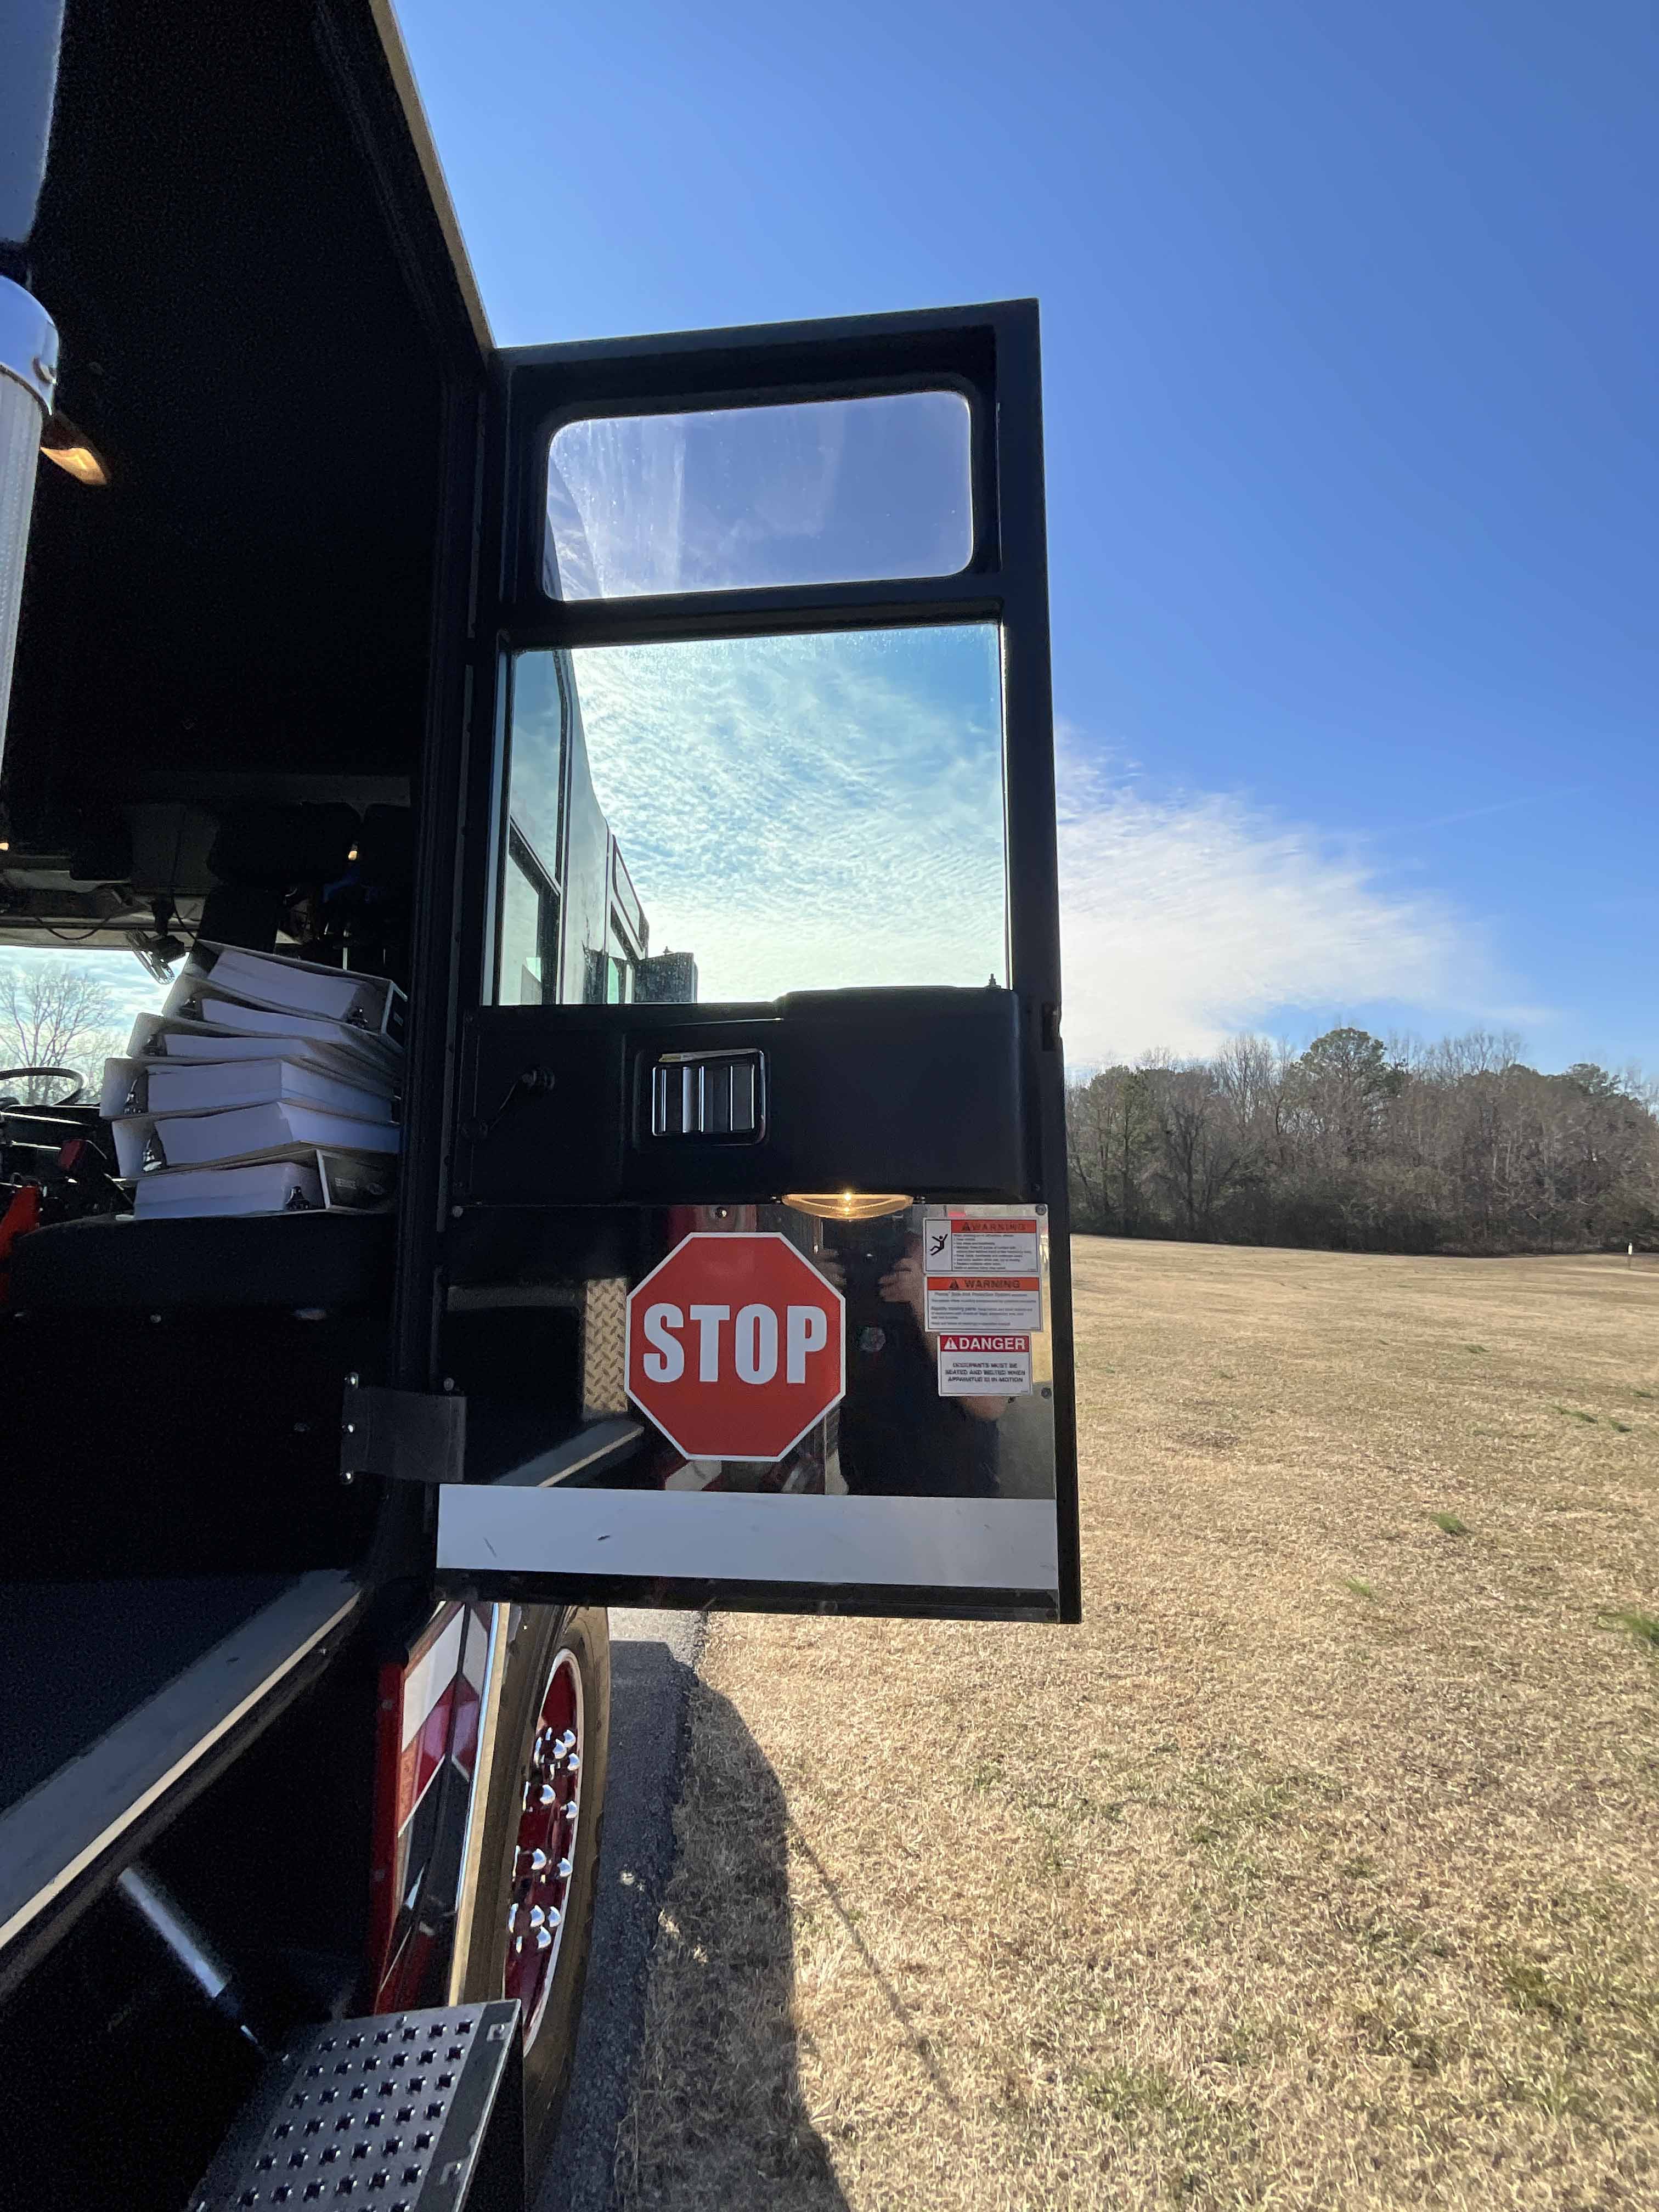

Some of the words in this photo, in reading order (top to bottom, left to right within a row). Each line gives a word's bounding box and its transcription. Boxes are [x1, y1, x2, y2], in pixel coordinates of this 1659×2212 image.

[964, 1280, 1020, 1288] WARNING
[644, 1302, 827, 1385] STOP
[958, 1338, 1026, 1350] DANGER
